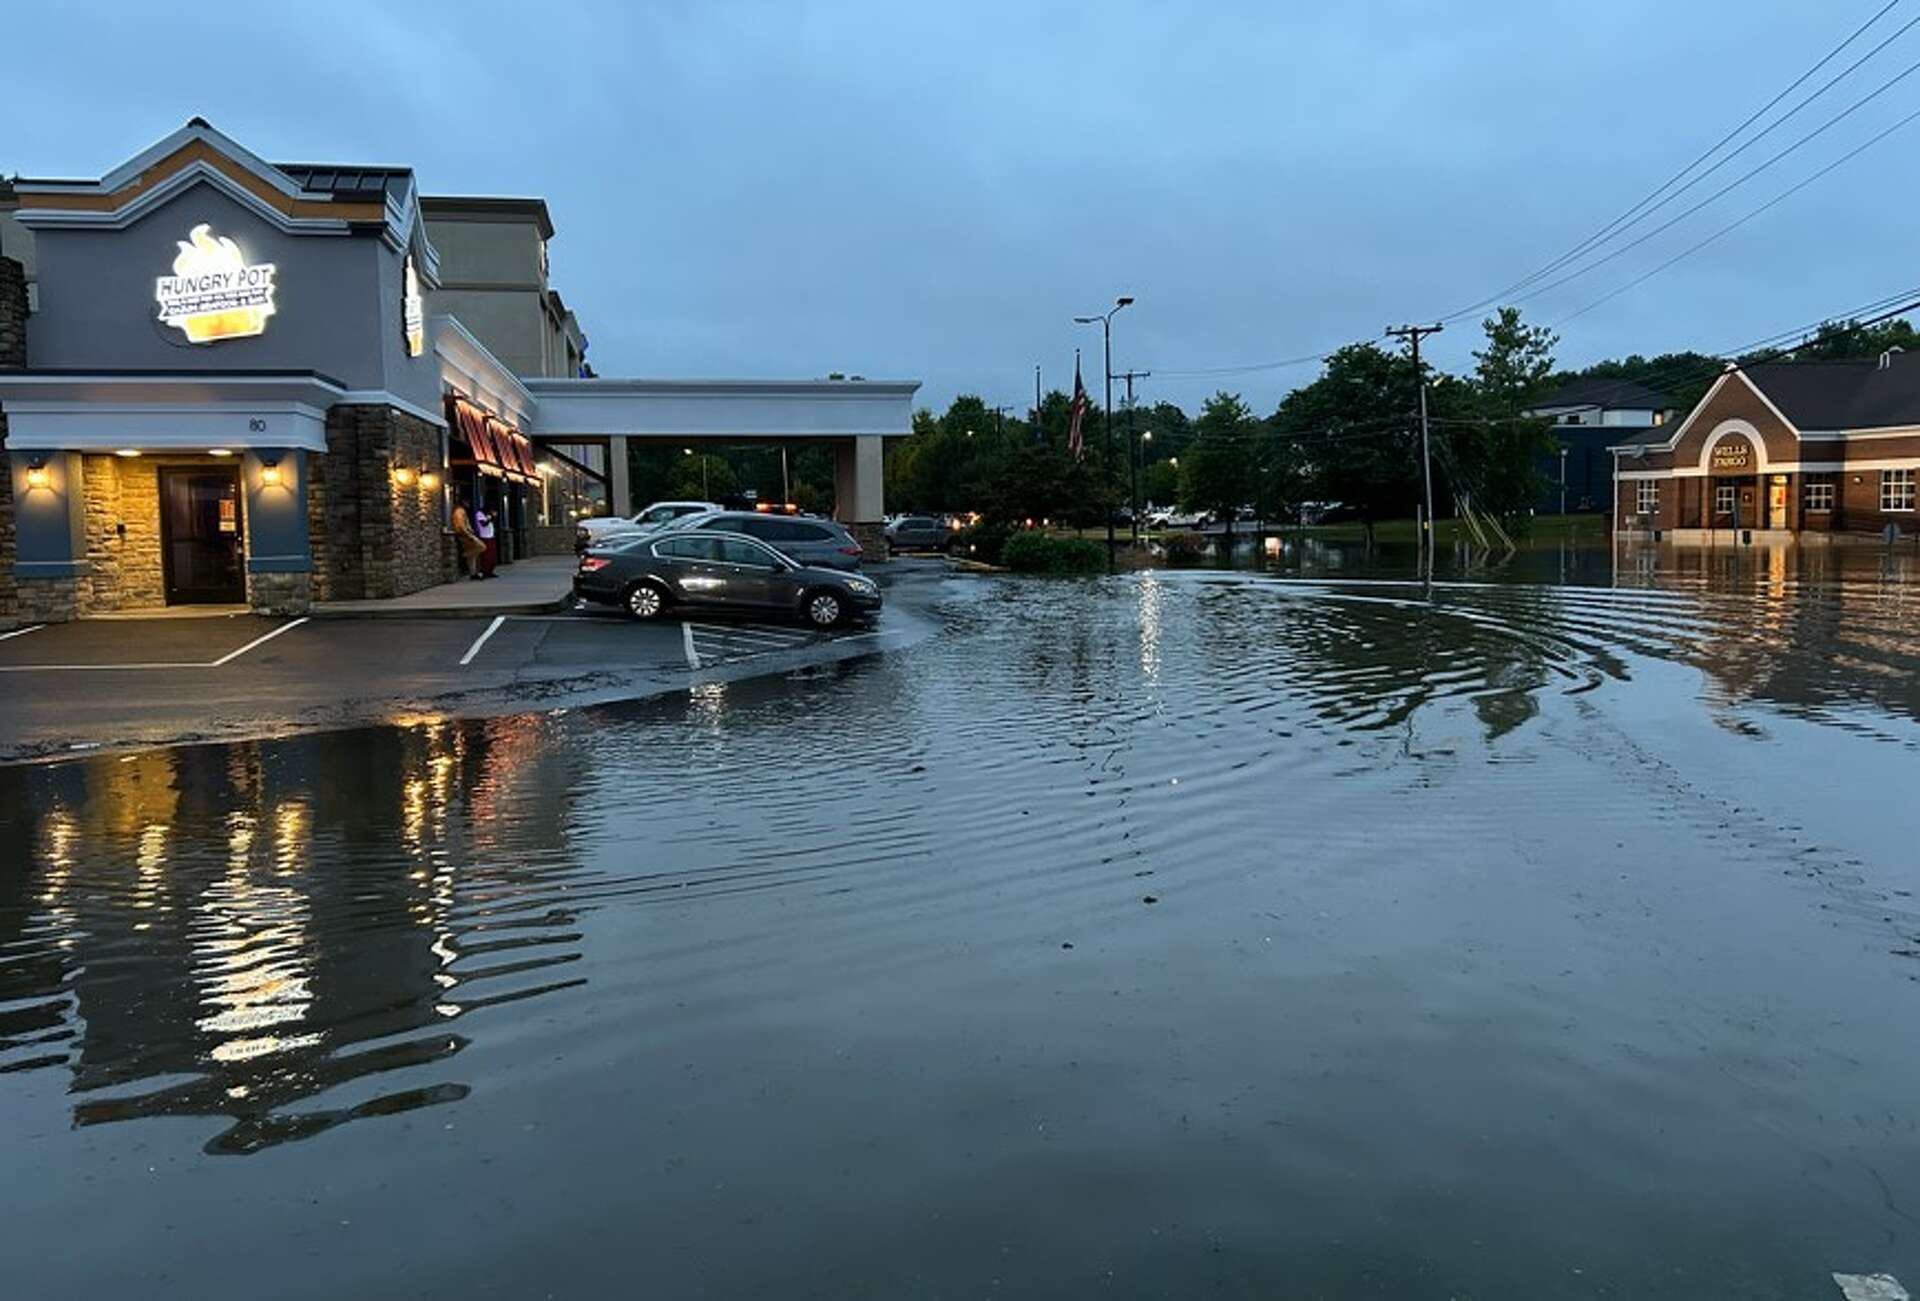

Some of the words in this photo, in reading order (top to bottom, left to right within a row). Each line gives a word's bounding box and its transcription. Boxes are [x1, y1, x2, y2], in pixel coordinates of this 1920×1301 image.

[160, 272, 233, 297] HUNGRY
[238, 268, 270, 287] POT
[249, 417, 266, 432] 80
[1713, 445, 1749, 456] WELLS
